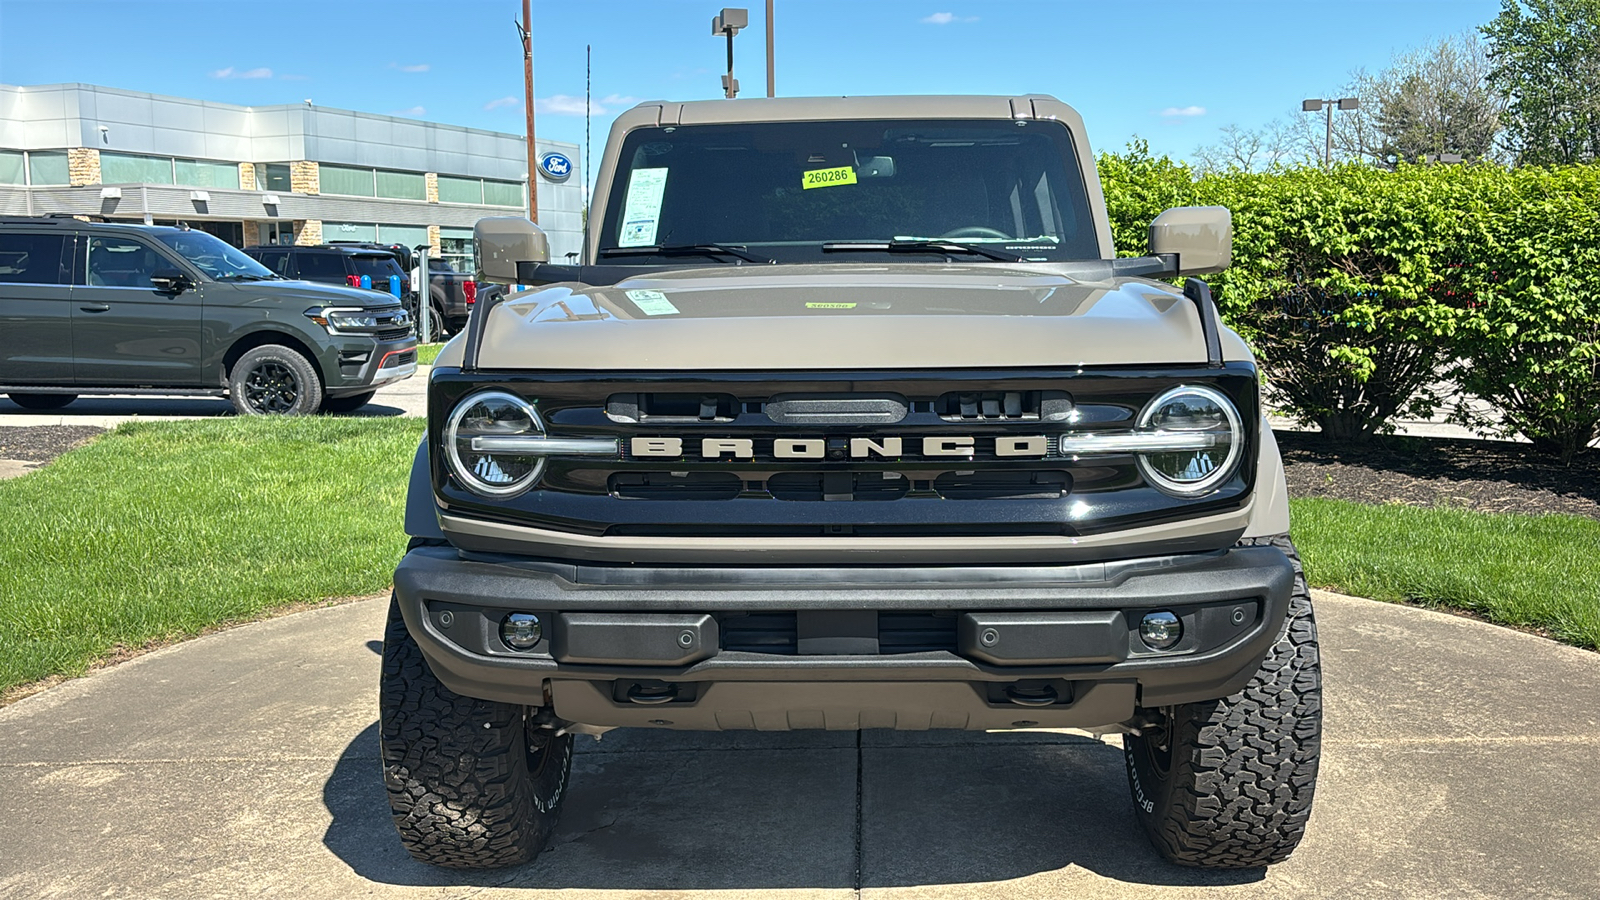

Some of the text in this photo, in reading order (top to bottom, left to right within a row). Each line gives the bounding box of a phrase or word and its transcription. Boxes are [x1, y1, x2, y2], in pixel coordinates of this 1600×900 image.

[548, 157, 568, 173] Ford
[808, 170, 848, 184] 260286
[630, 436, 1048, 459] BRONCO
